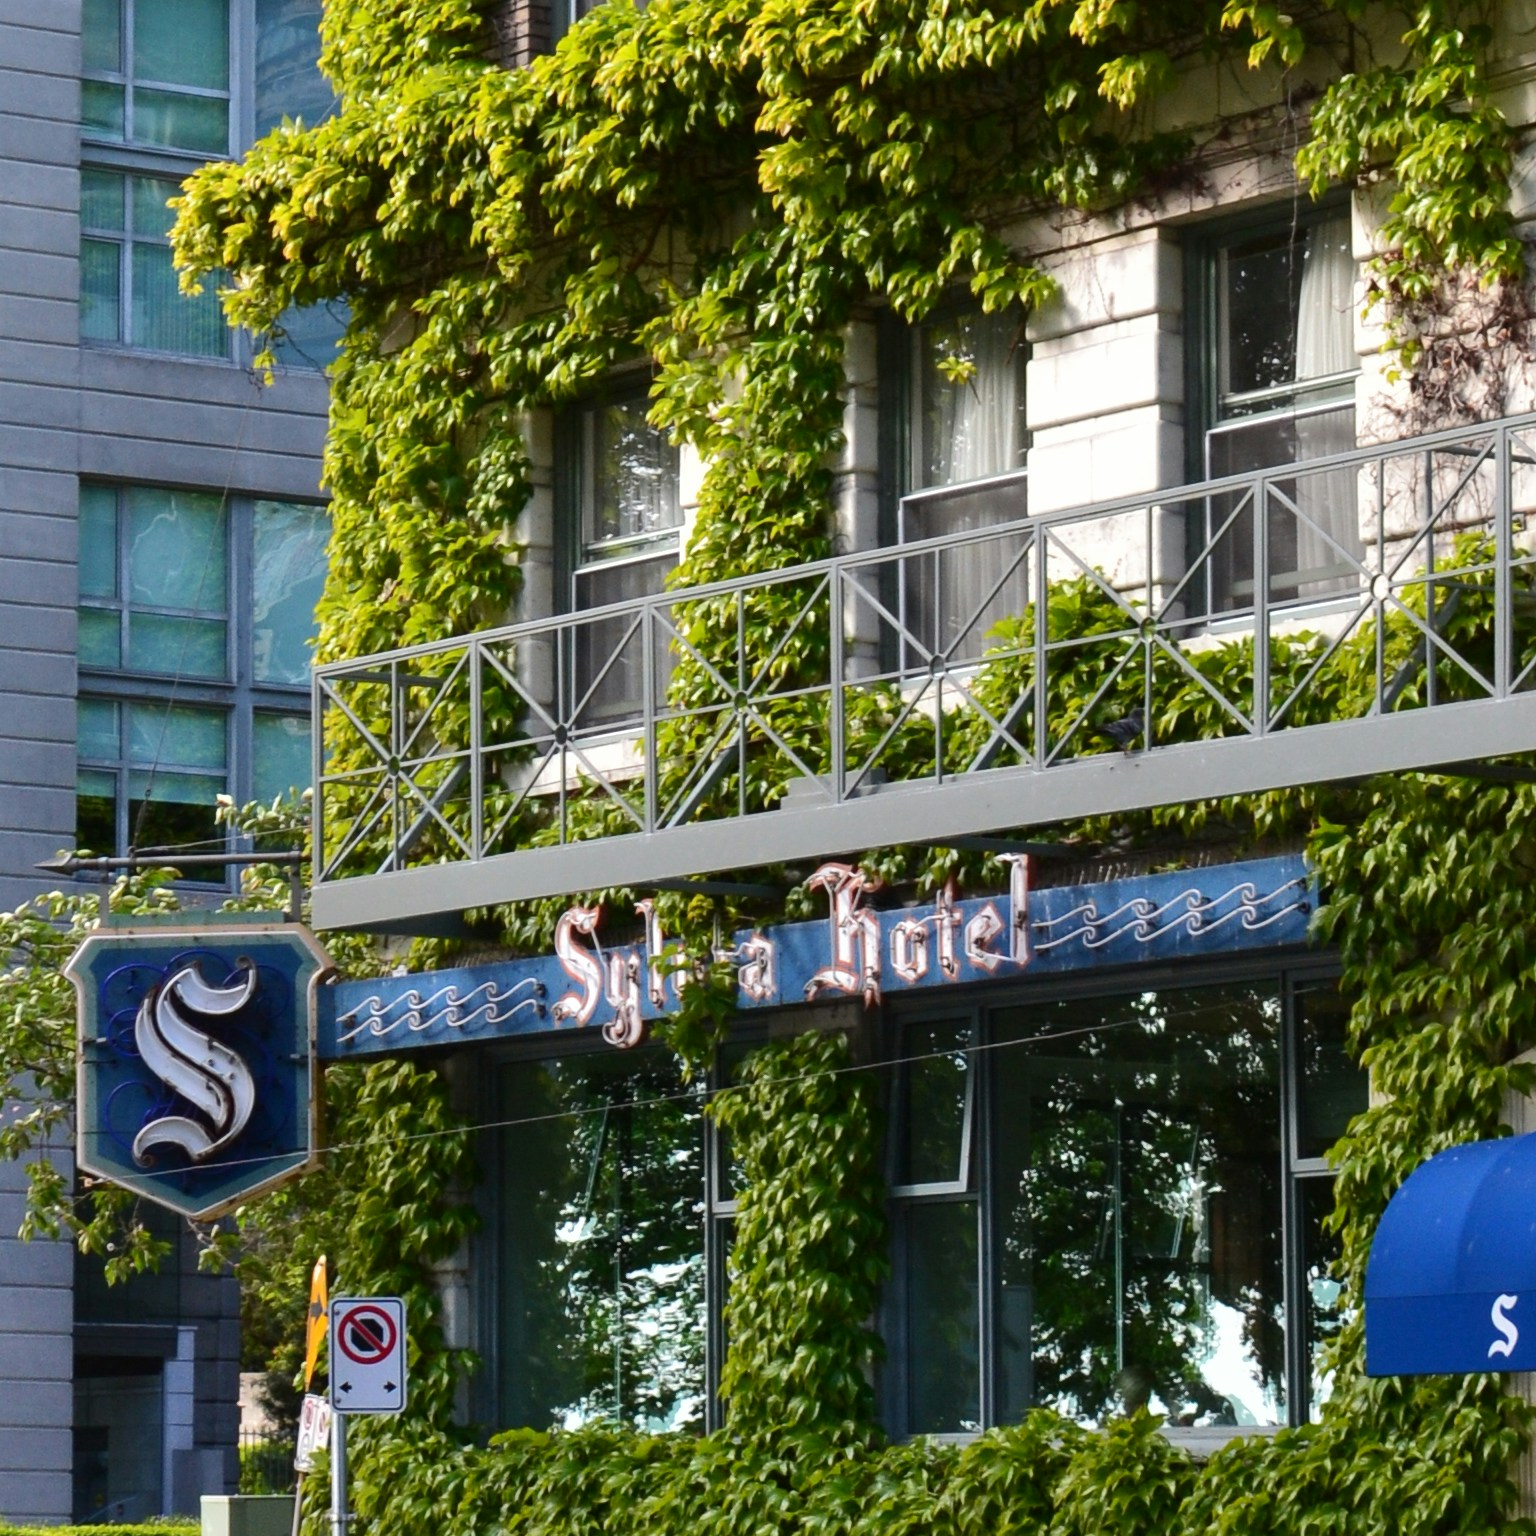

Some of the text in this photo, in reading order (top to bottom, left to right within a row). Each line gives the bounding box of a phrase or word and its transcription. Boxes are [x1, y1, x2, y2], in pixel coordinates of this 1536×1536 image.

[551, 852, 1029, 1049] Syla Hotel
[132, 955, 257, 1167] S
[1487, 1293, 1519, 1358] S
